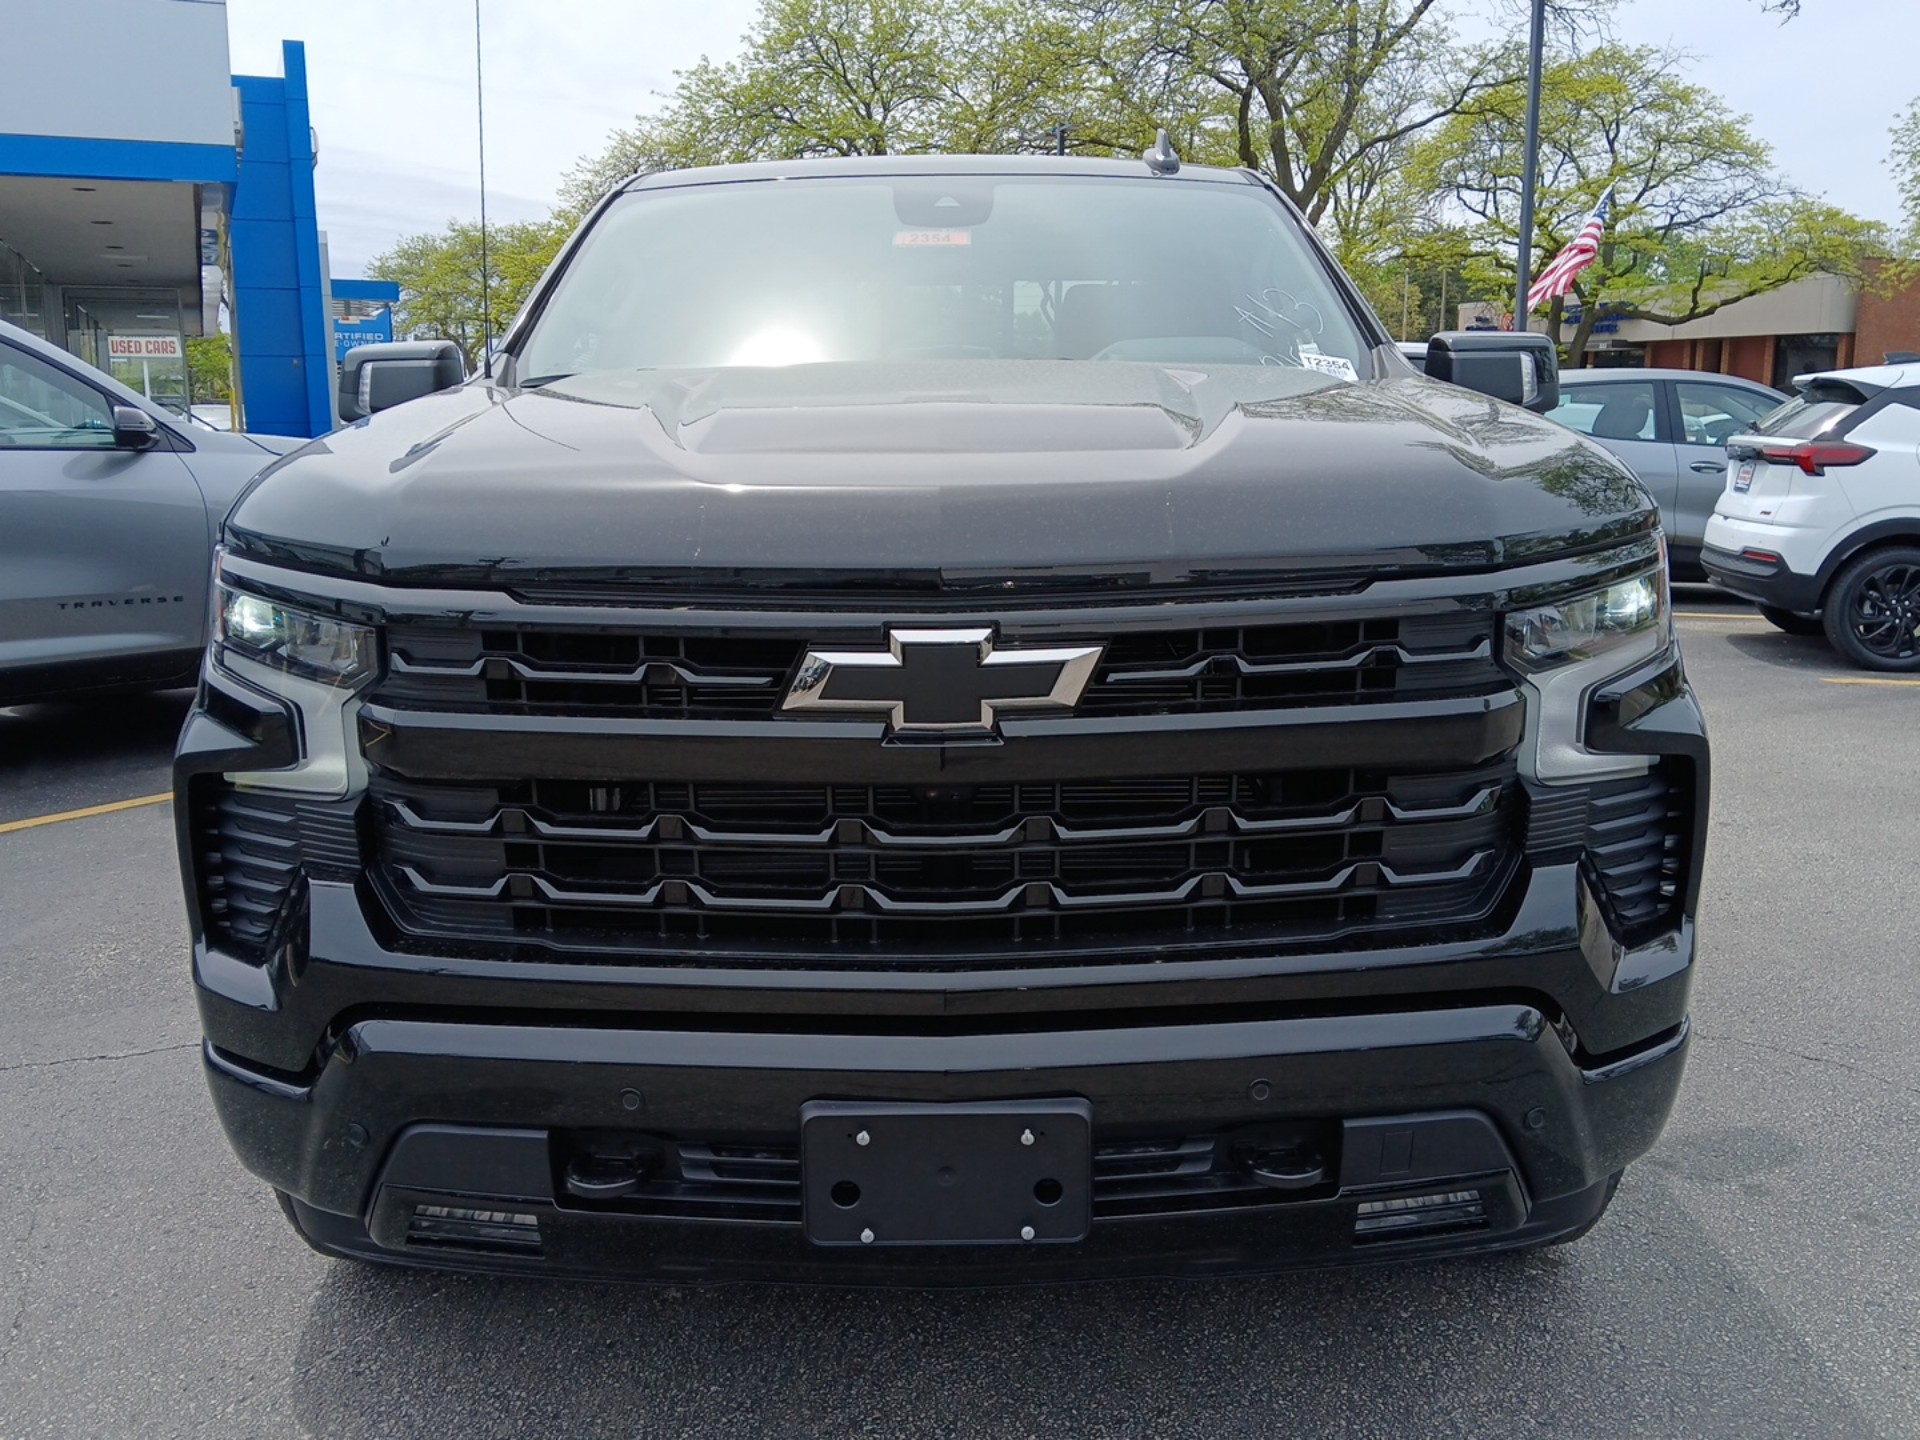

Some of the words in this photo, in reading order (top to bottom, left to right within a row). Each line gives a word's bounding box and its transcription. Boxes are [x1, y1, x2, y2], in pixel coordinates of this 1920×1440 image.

[111, 340, 142, 354] USED
[145, 340, 177, 354] CARS
[1303, 356, 1351, 371] T2354
[57, 595, 184, 610] TRAVERSE
